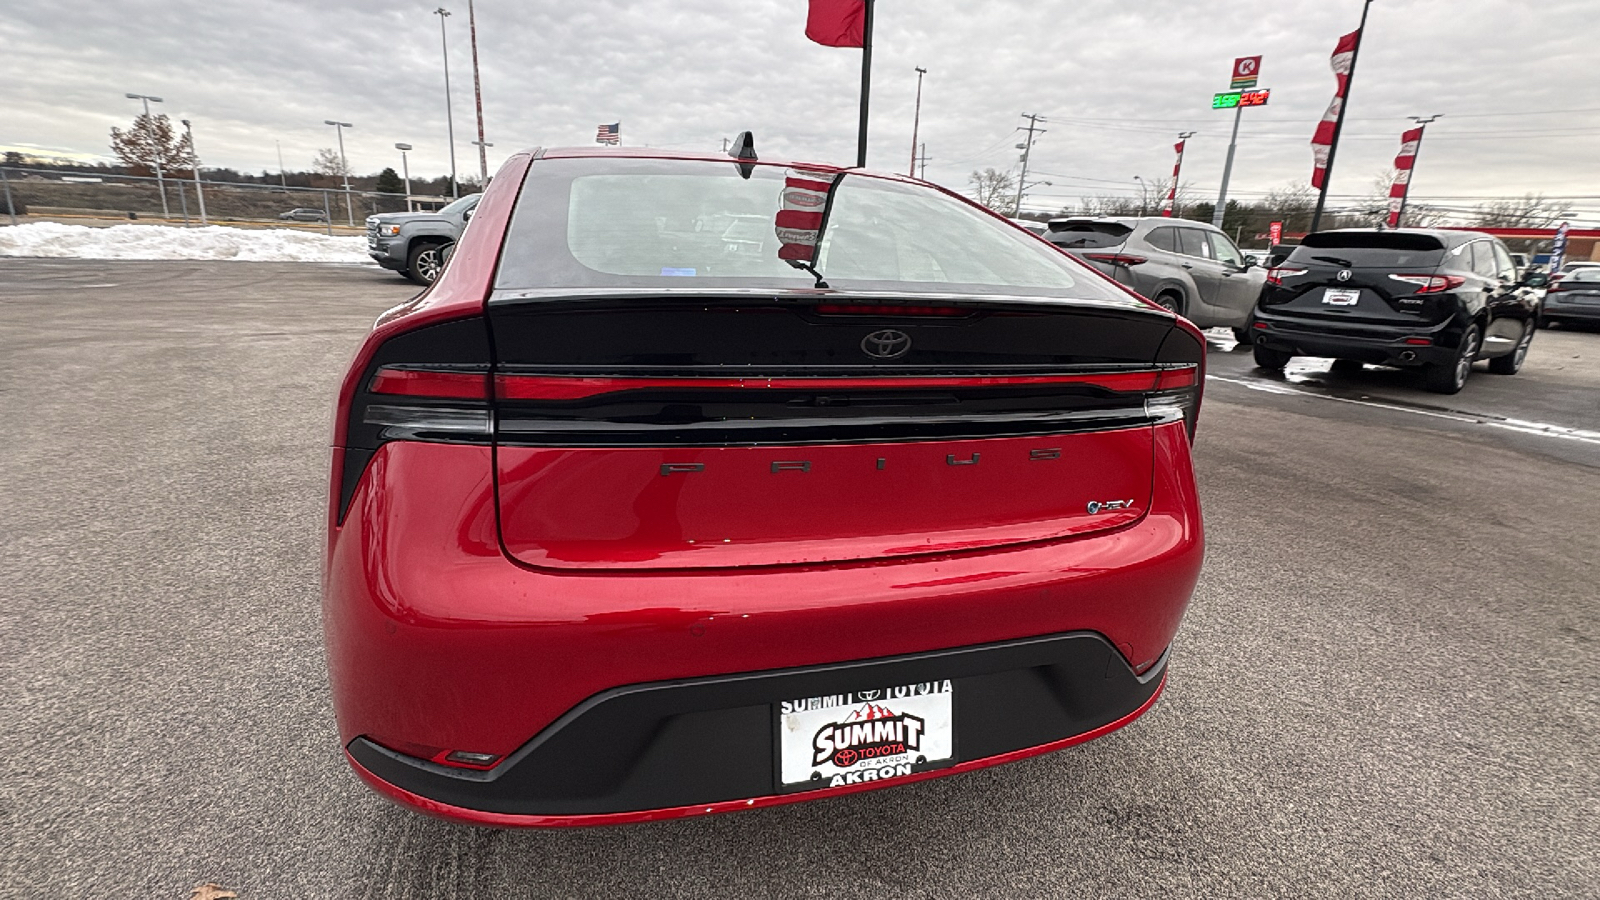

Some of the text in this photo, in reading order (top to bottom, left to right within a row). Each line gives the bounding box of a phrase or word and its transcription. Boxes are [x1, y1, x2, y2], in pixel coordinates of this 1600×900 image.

[1242, 61, 1252, 72] K
[660, 448, 1062, 476] PRIUS
[815, 716, 923, 763] SUMMIT
[859, 743, 905, 758] TOYOTA
[860, 755, 909, 768] OF AKRON
[829, 764, 912, 787] AKRON
